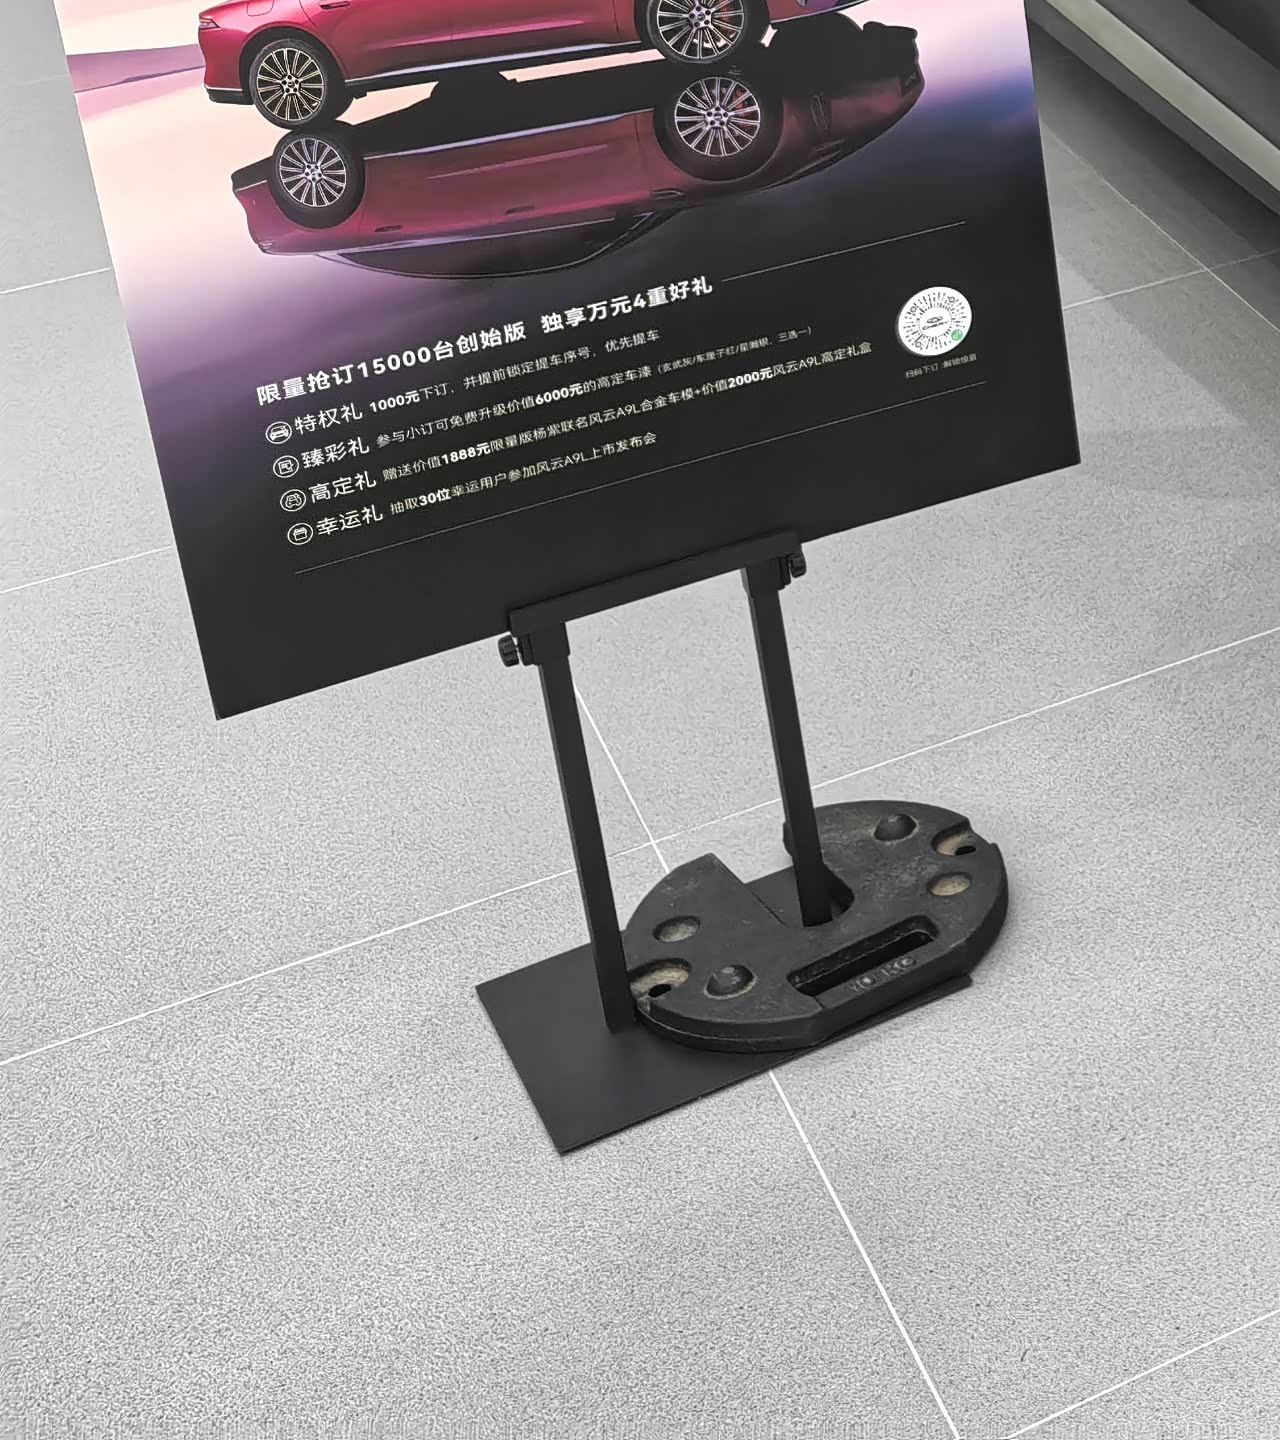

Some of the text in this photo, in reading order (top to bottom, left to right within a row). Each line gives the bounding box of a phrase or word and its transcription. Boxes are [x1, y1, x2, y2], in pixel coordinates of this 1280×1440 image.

[256, 275, 713, 406] 限量抢订15000台创始版 独享万元4重好礼
[294, 402, 363, 435] 特权礼
[301, 436, 370, 470] 臻彩礼
[309, 470, 377, 504] 高定礼
[316, 431, 657, 538] 幸运礼 抽取30位幸运用户参加风云A9L上市发布会
